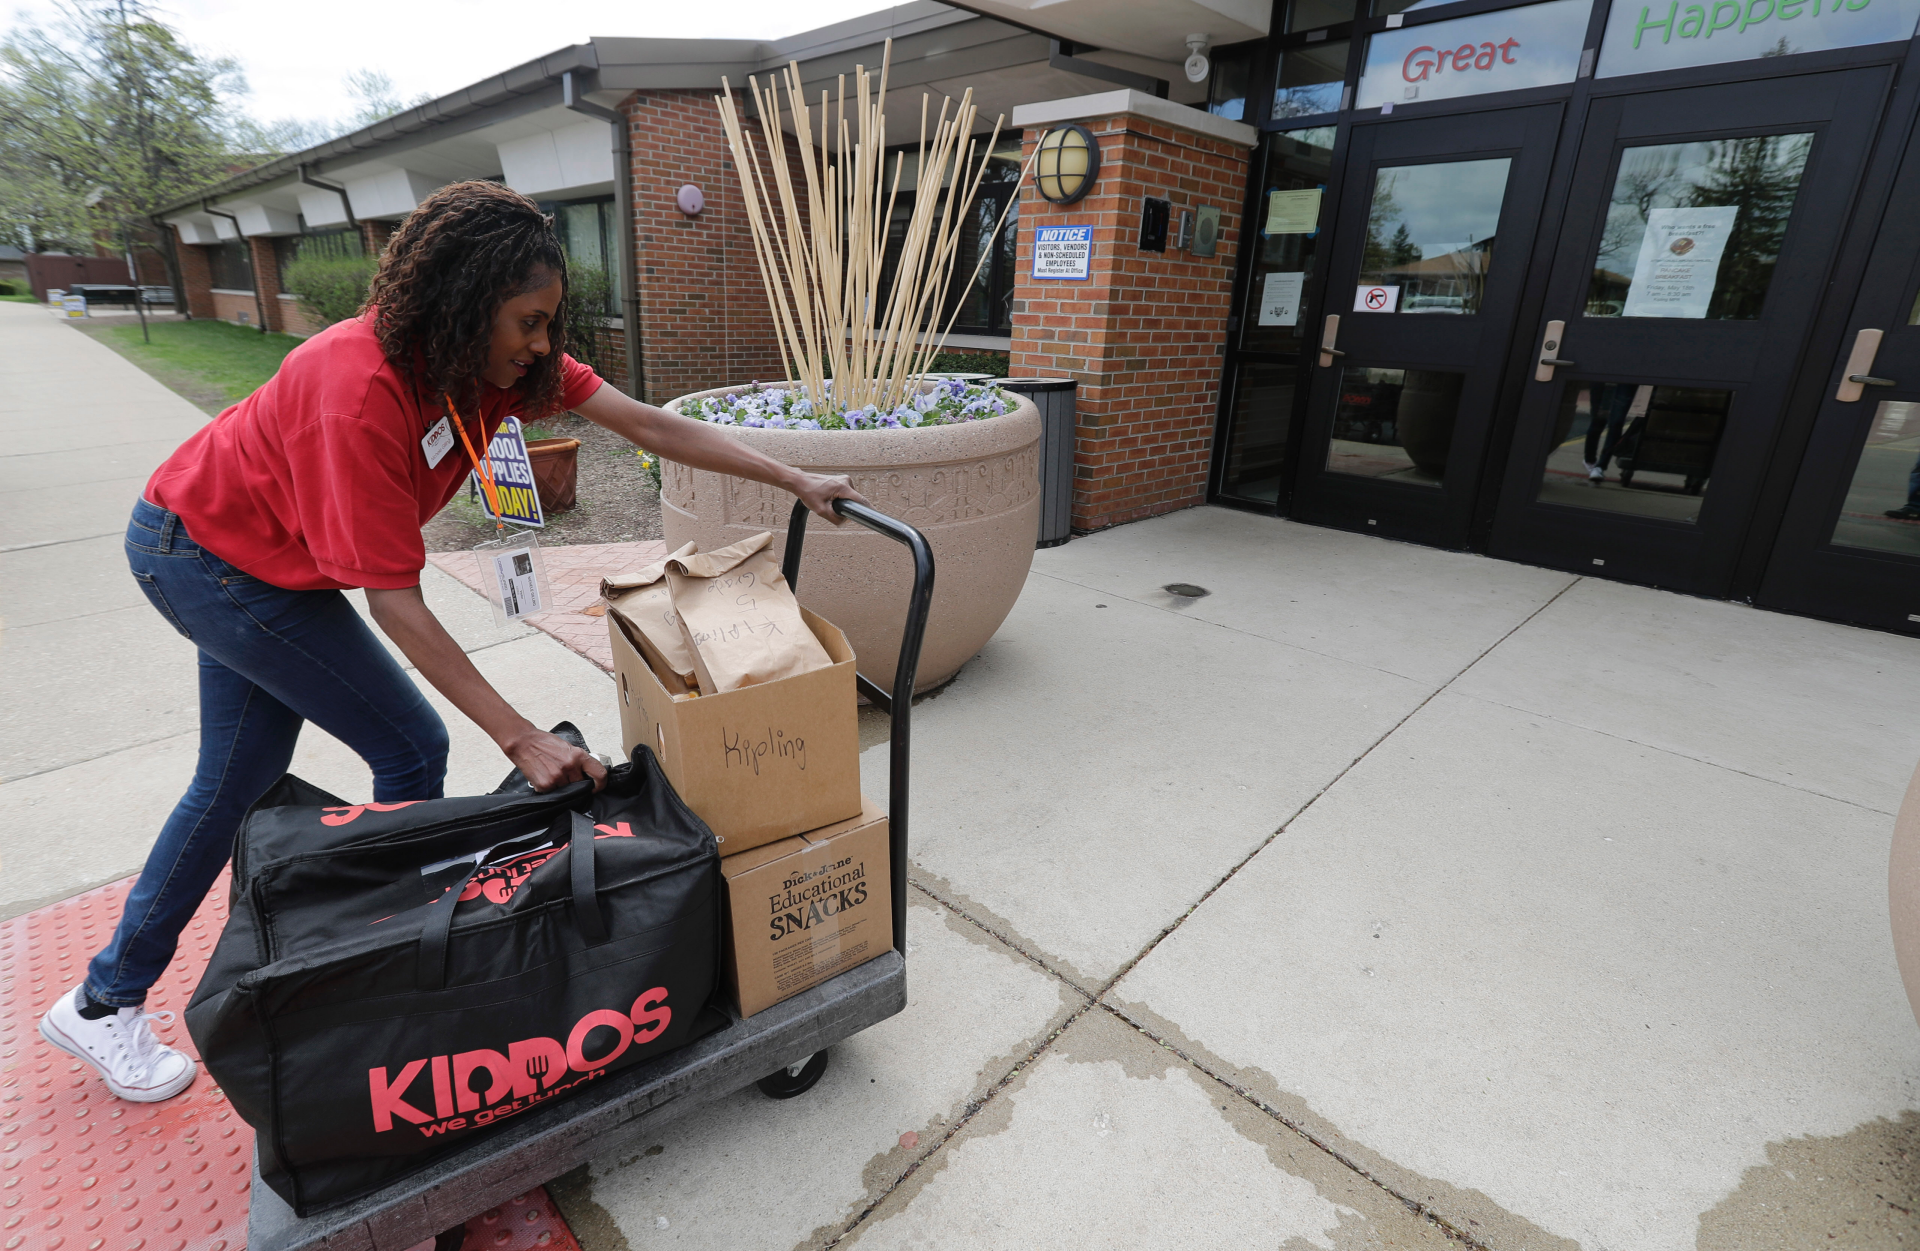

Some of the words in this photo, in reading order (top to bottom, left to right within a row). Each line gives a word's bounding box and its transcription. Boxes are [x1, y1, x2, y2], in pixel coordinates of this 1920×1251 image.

[1402, 36, 1520, 83] Great
[1038, 243, 1062, 251] VISITORS,
[1063, 243, 1088, 251] VENDORS
[1040, 229, 1087, 241] NOTICE
[1043, 251, 1085, 259] NON-SCHEDULED
[735, 594, 758, 613] 5
[722, 726, 806, 776] Kipling
[768, 861, 866, 915] Educational
[769, 881, 868, 941] SNACKS
[368, 986, 672, 1133] KIDDOS
[418, 1117, 467, 1138] we
[473, 1100, 523, 1125] get
[528, 1068, 606, 1104] lunch
